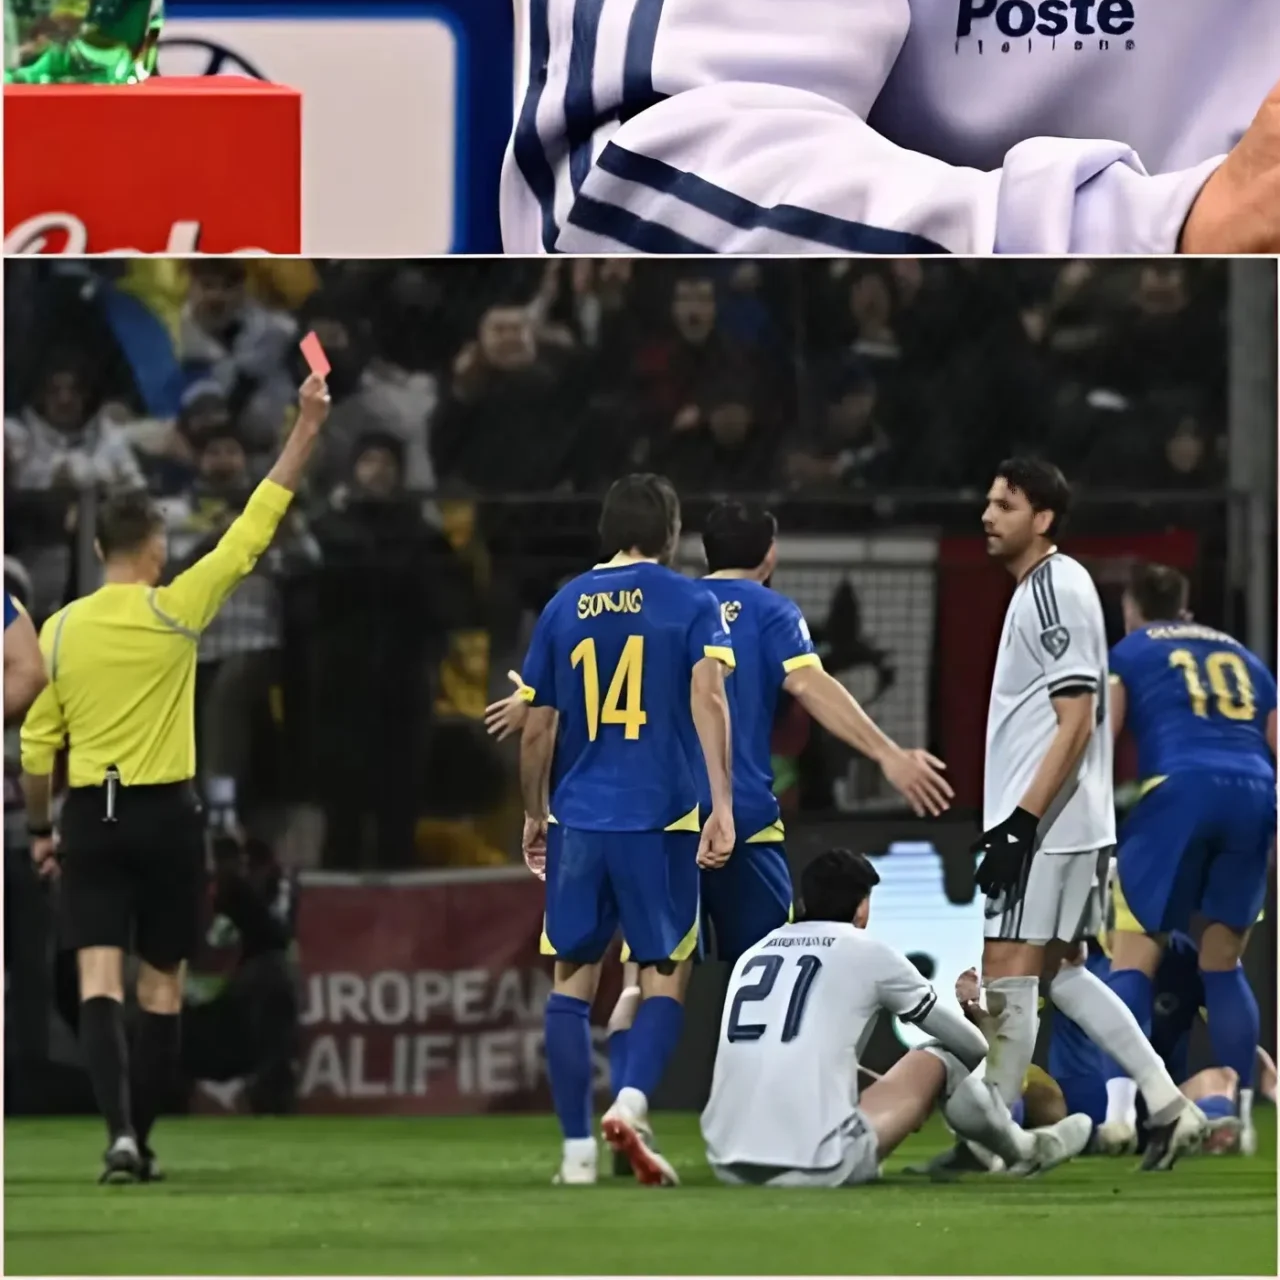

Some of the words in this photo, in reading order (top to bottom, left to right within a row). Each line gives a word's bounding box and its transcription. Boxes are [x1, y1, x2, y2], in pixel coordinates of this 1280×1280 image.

[569, 633, 648, 743] 14
[1167, 648, 1257, 721] 10
[726, 953, 824, 1044] 21
